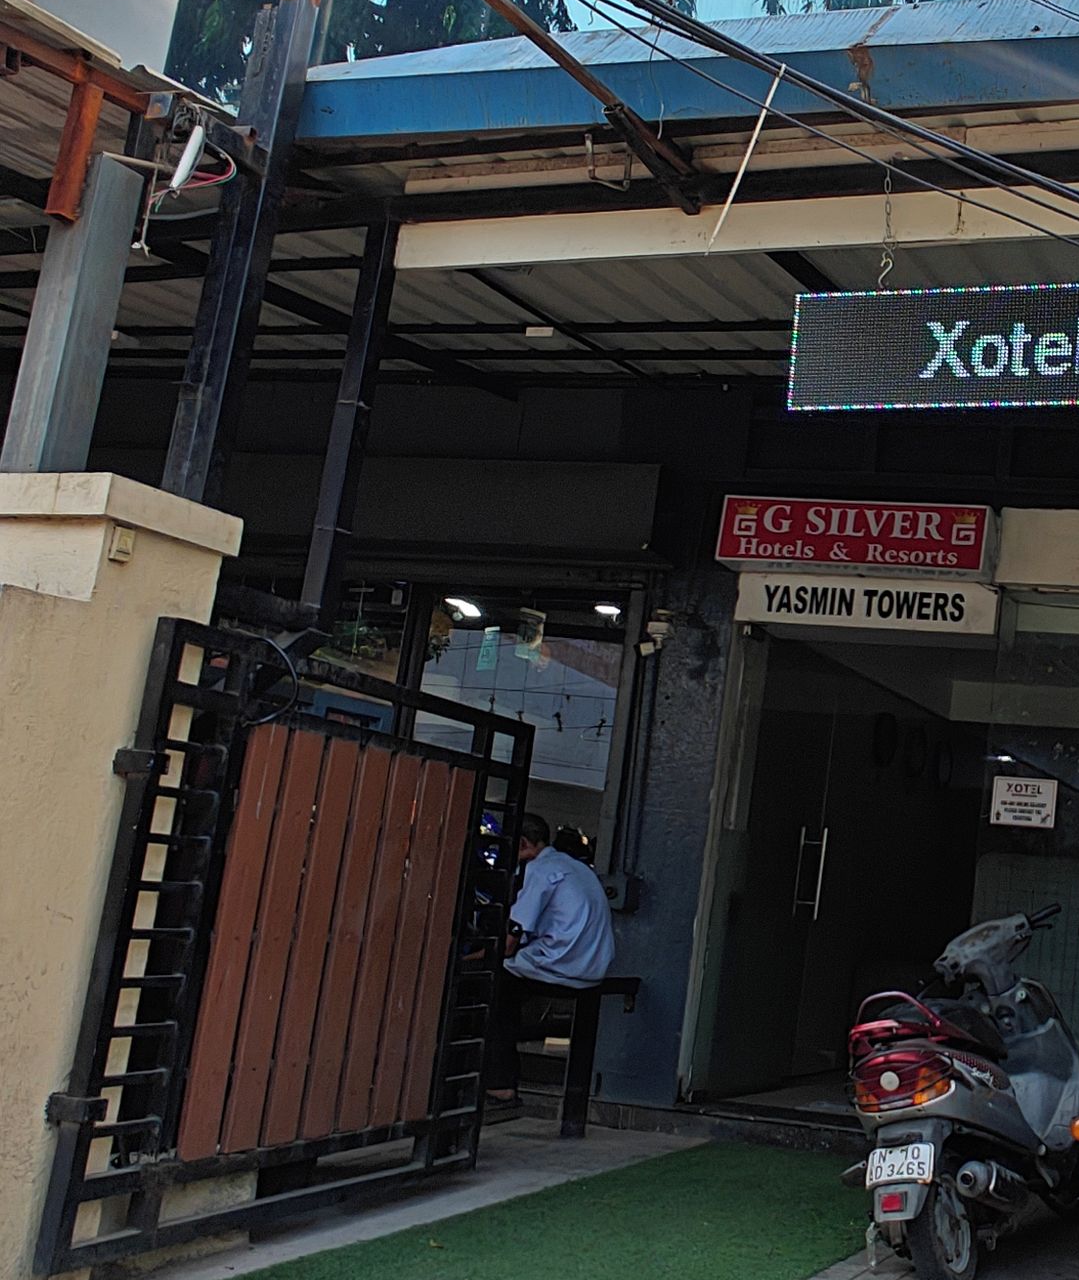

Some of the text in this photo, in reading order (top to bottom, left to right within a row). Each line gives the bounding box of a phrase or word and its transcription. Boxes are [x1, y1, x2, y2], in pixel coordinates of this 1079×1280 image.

[763, 504, 793, 534] G
[805, 506, 945, 541] SILVER
[737, 536, 958, 566] Hotels & Resorts
[764, 584, 966, 622] YASMIN TOWERS
[1006, 782, 1043, 795] XOTEL
